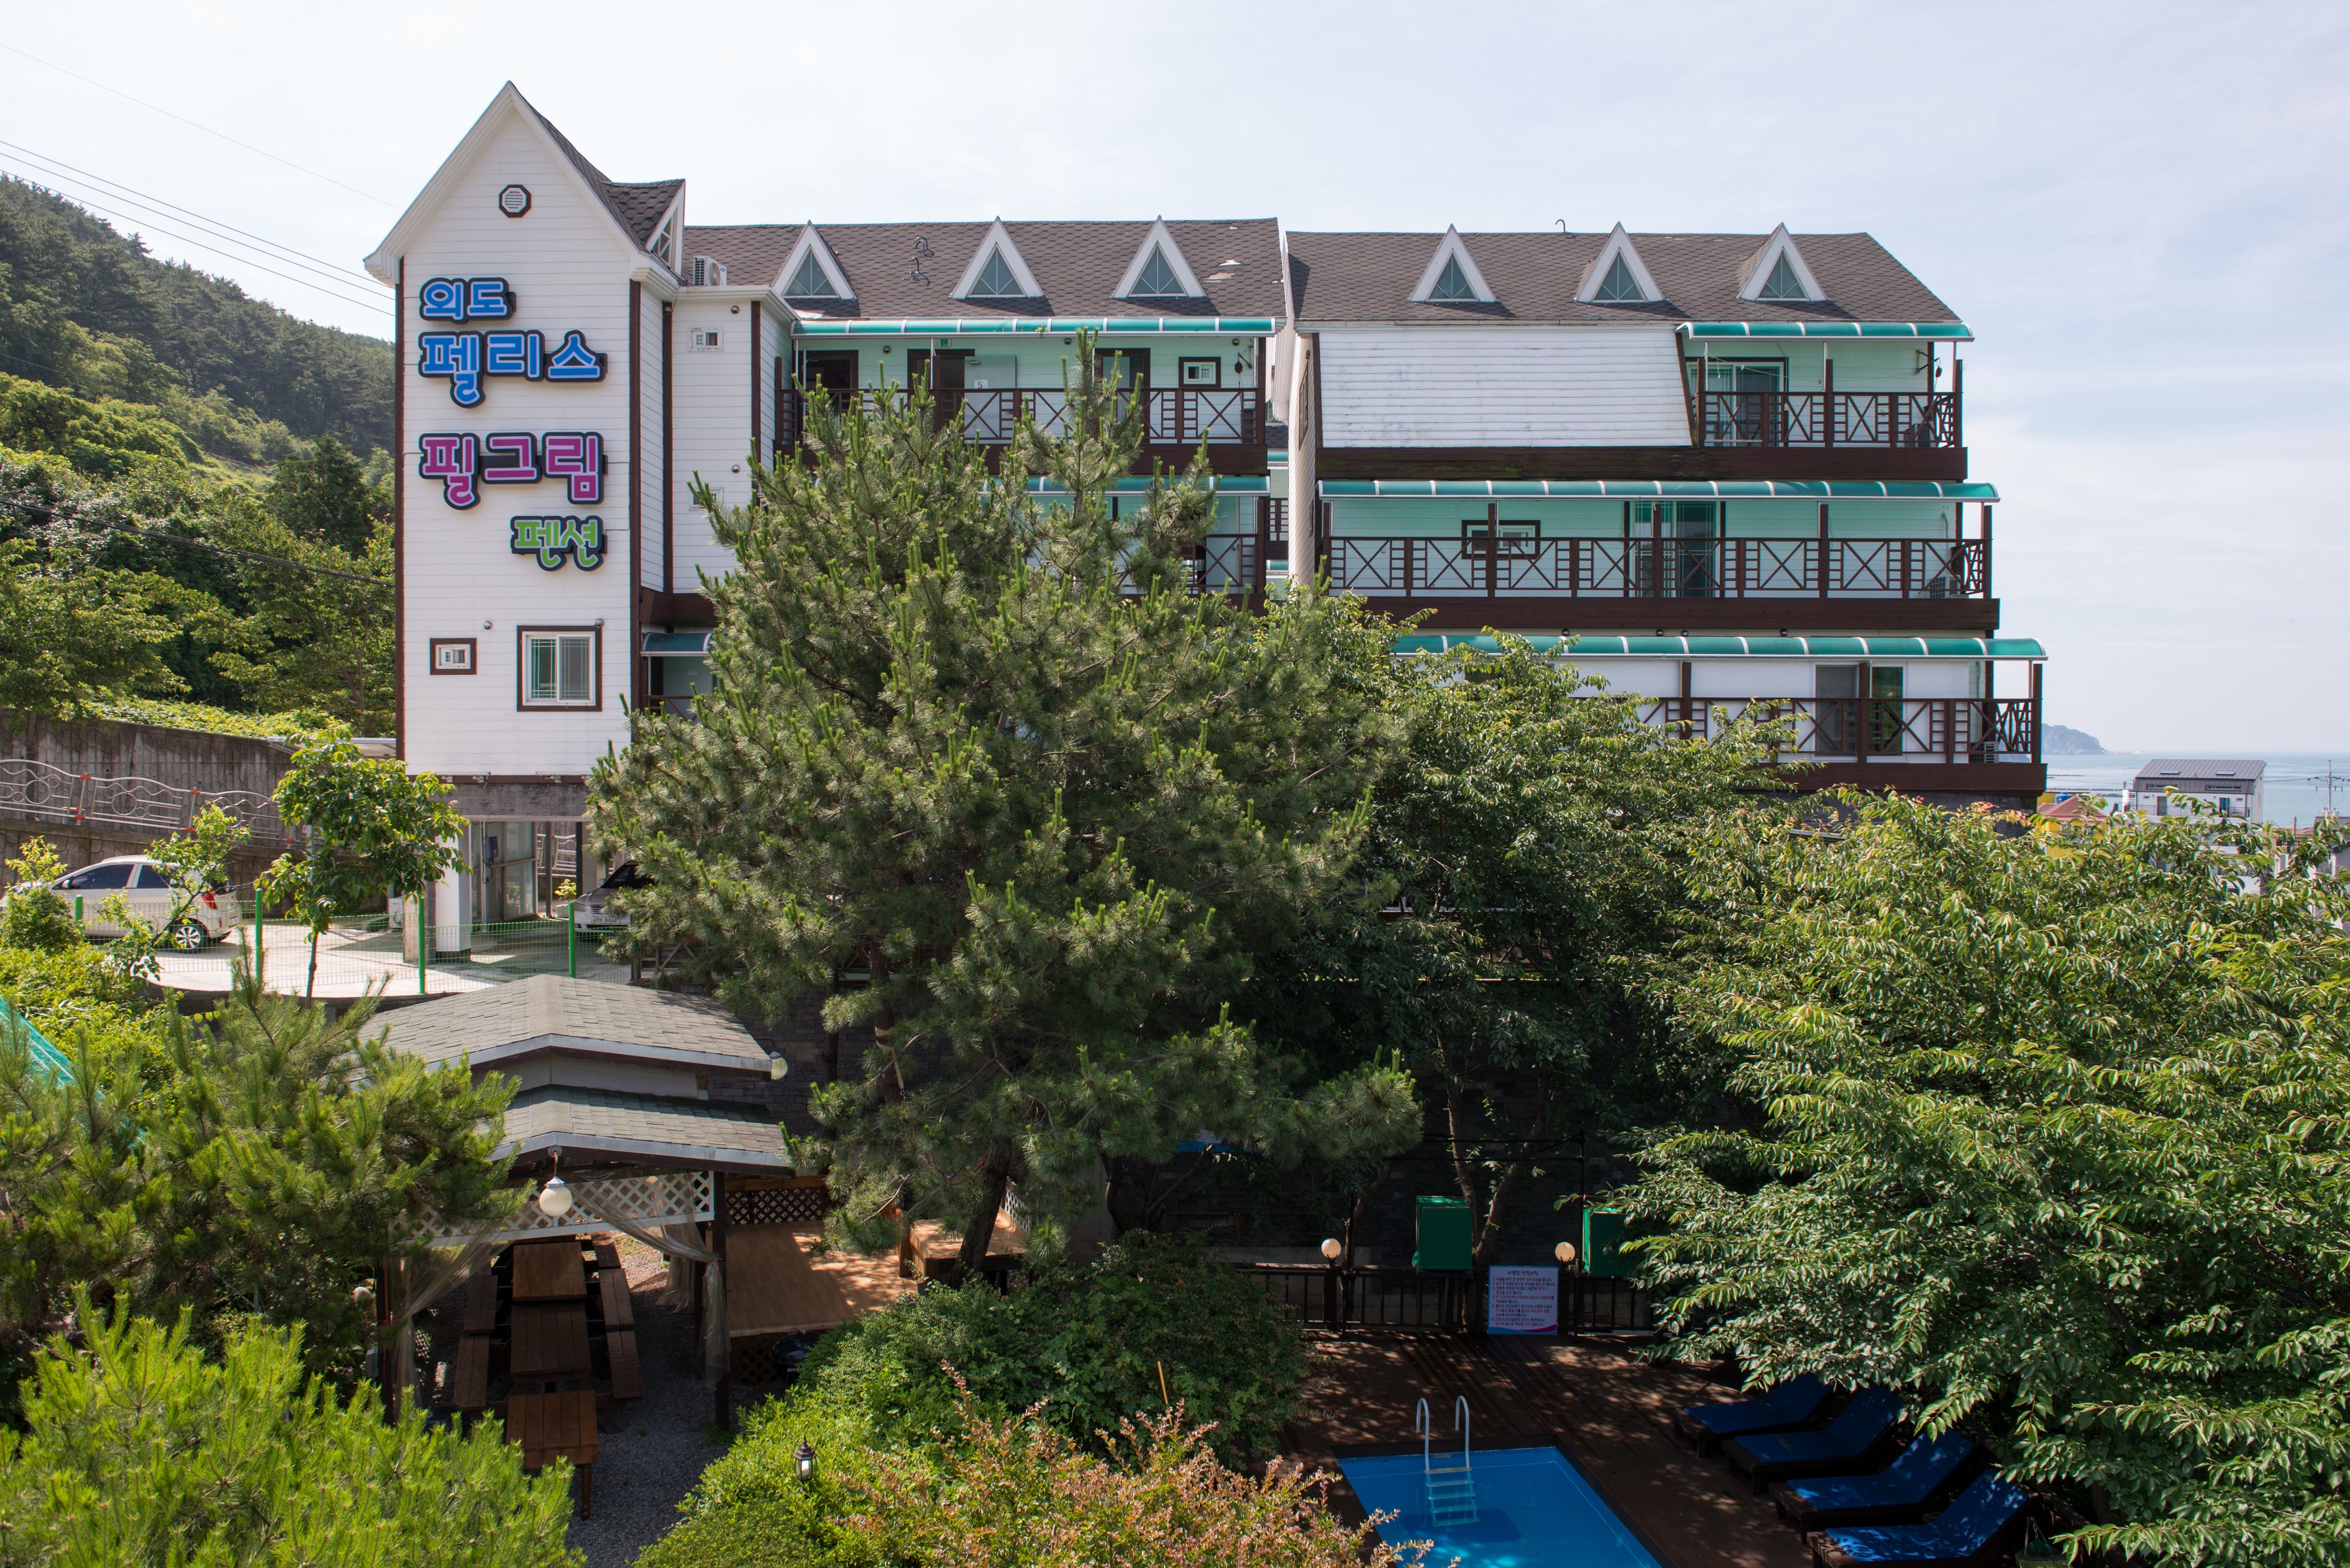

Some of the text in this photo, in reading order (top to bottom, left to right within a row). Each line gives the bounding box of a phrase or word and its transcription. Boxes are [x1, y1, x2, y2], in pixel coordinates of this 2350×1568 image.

[420, 278, 510, 323] 외도
[420, 331, 604, 407] 펠리스
[420, 433, 603, 509] 필그림
[512, 516, 603, 570] 펜션
